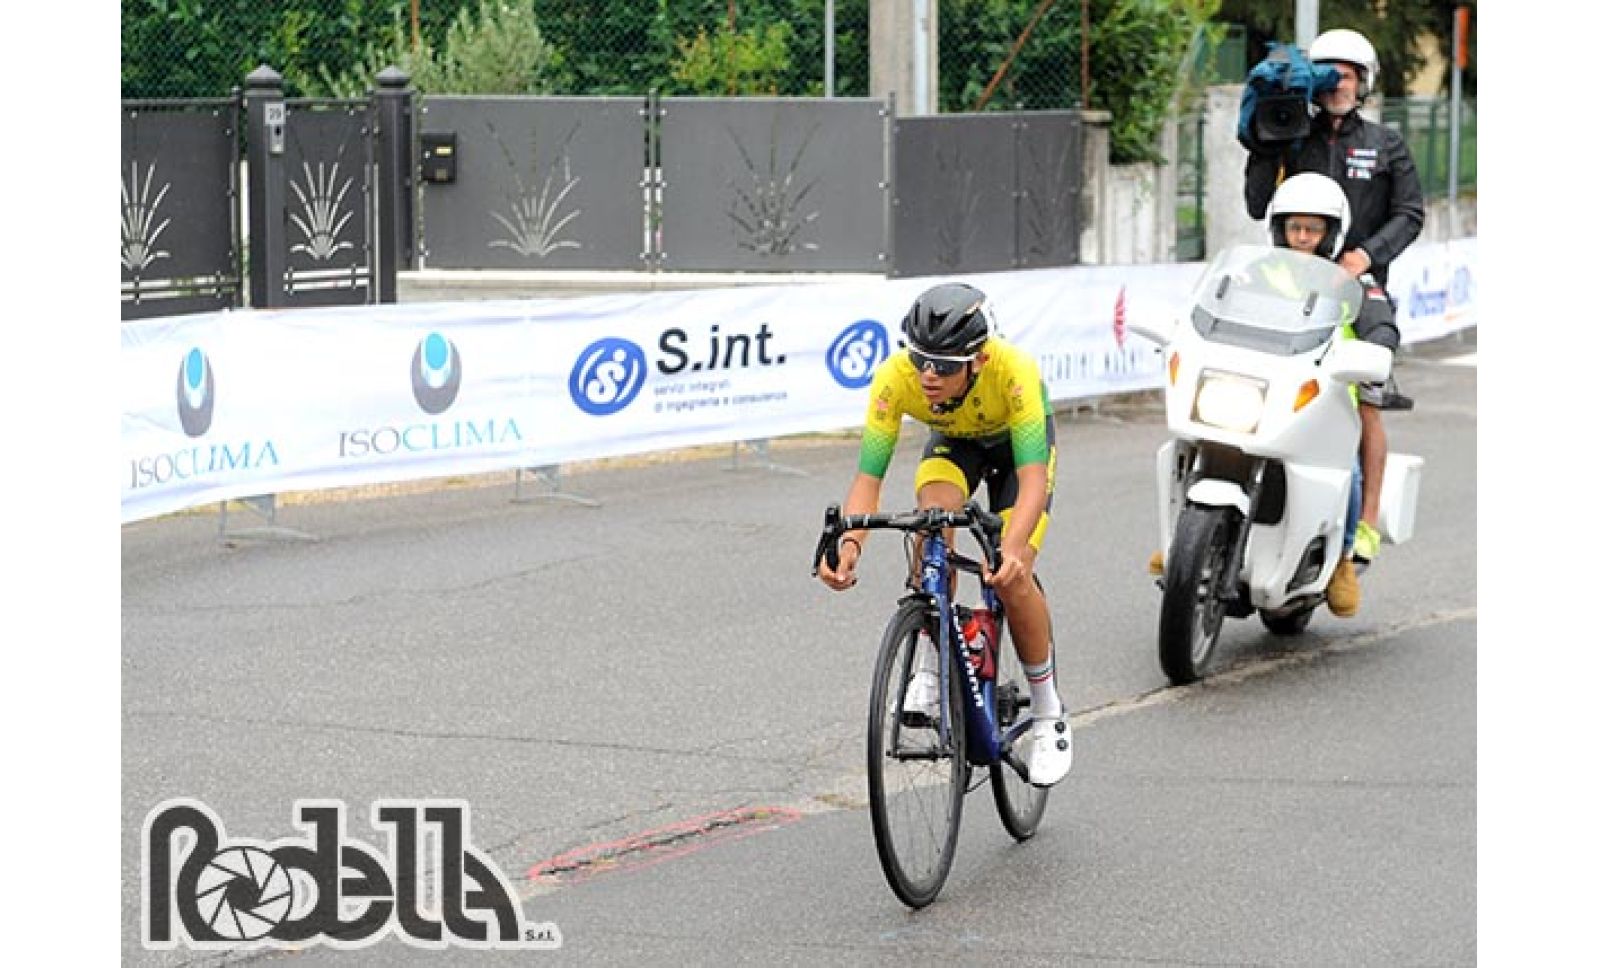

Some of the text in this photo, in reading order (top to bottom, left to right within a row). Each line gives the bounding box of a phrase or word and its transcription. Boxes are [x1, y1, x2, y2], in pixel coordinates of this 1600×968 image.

[656, 322, 788, 376] S.int.
[339, 417, 523, 458] ISOCLIMA
[131, 440, 281, 489] ISOCLIMA
